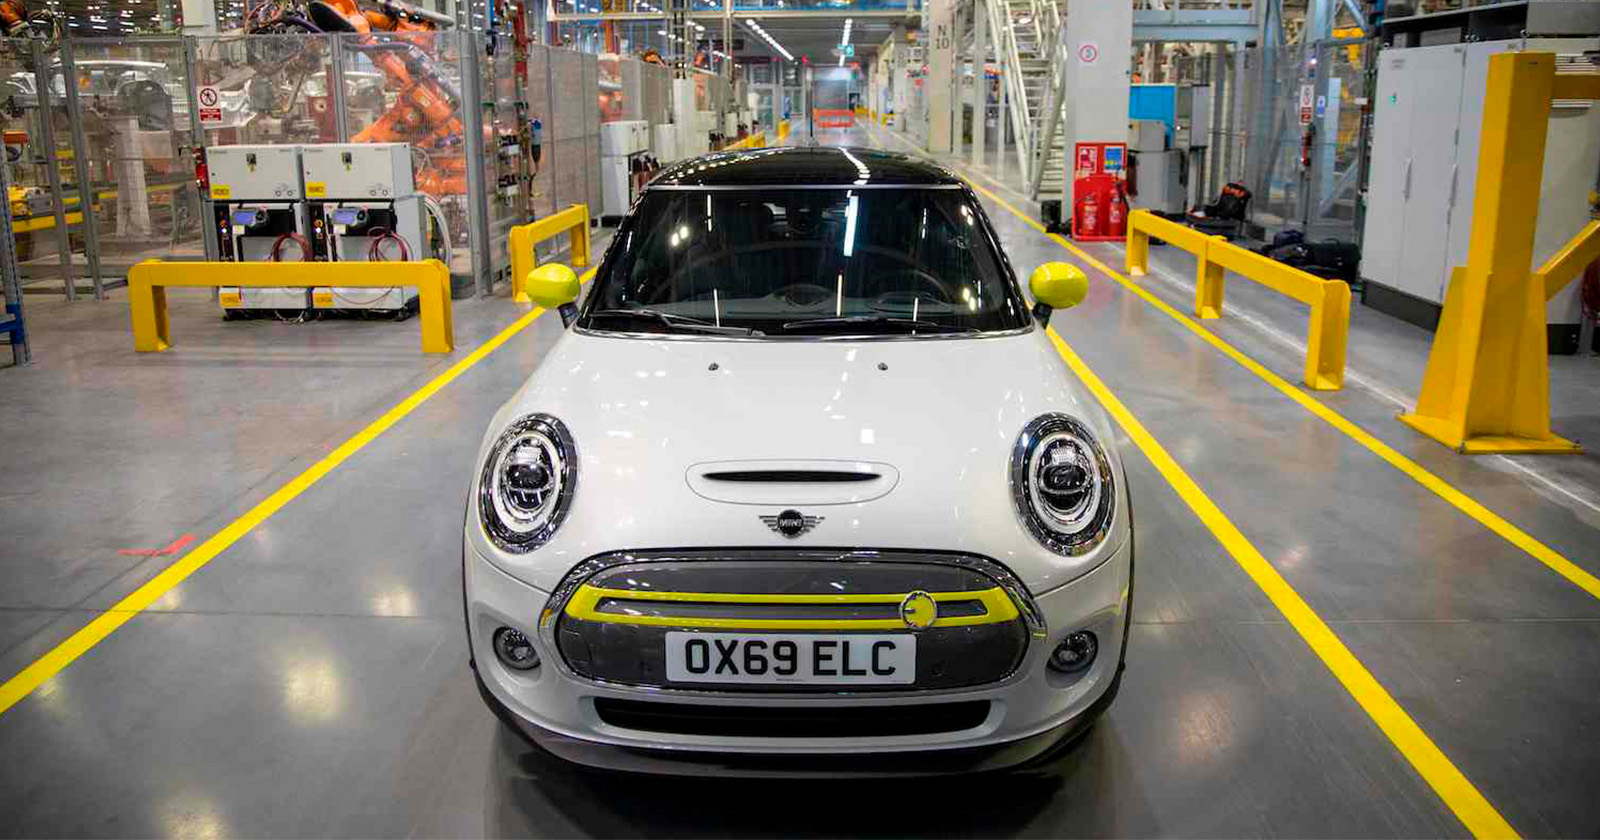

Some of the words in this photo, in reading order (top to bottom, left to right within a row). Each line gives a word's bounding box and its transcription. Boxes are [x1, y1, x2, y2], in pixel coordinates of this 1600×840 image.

[936, 37, 950, 49] 10
[779, 518, 802, 527] MINI
[685, 639, 798, 676] OX69
[813, 640, 897, 676] ELC
